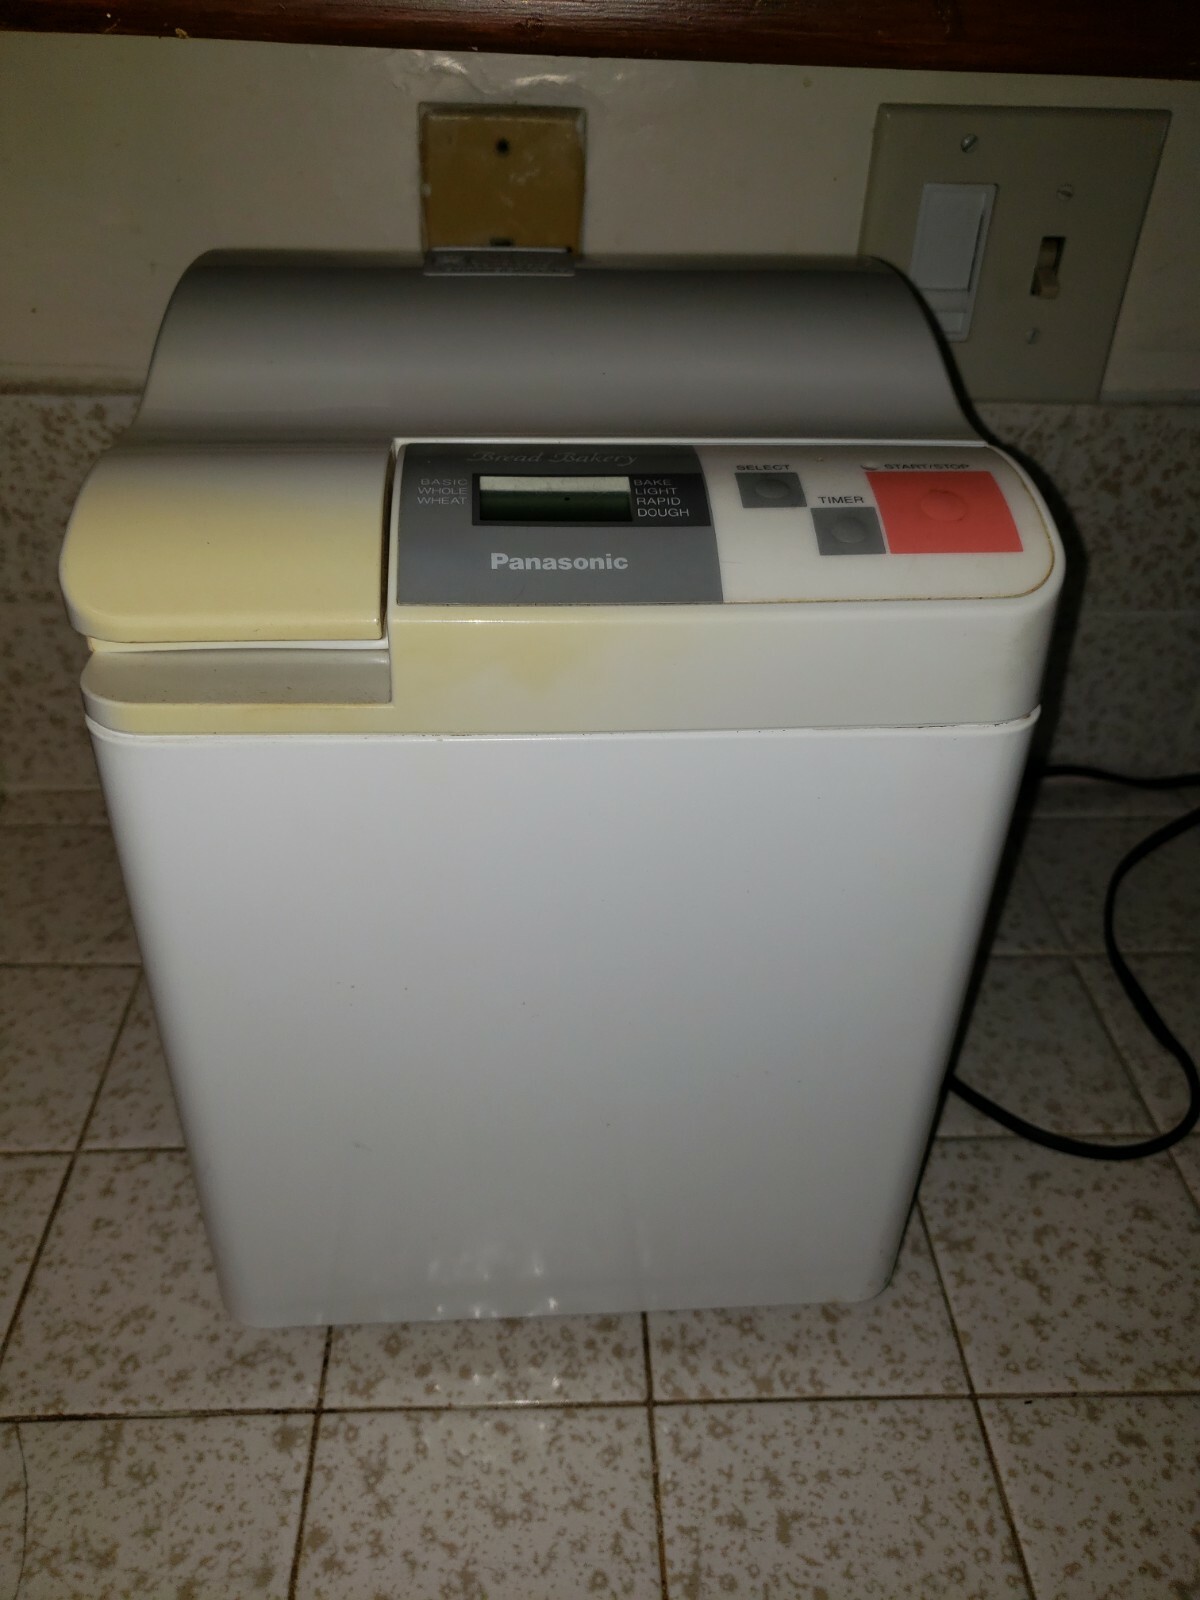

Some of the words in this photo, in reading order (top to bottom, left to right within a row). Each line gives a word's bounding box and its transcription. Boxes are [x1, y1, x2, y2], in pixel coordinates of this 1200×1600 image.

[420, 478, 468, 486] BASIC
[418, 487, 468, 495] WHOLE
[635, 487, 678, 496] LIGHT
[417, 497, 468, 505] WHEAT
[636, 497, 681, 506] RAPID
[818, 496, 864, 504] TIMER
[637, 508, 690, 518] DOUGH
[490, 552, 629, 571] Panasonic
